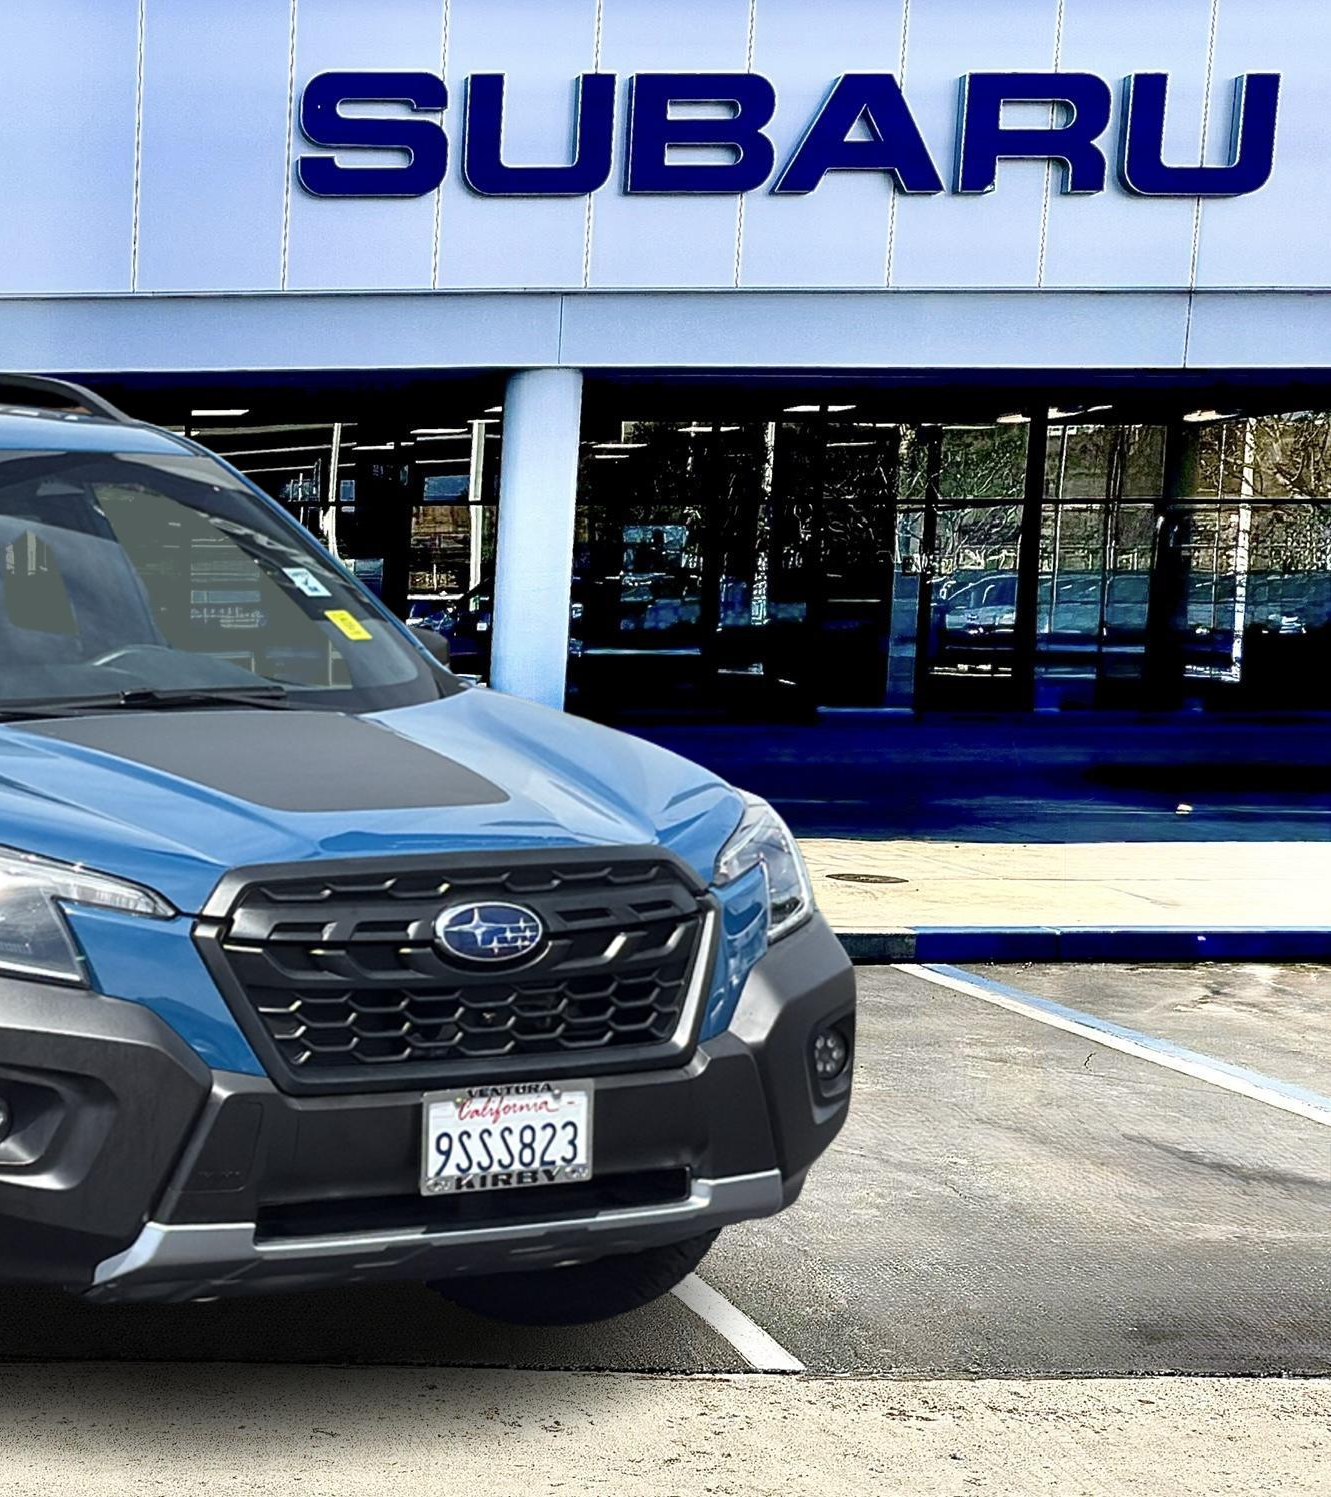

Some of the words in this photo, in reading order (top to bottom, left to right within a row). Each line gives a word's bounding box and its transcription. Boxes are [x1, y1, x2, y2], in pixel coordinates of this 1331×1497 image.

[297, 71, 1282, 196] SUBARU
[467, 1083, 553, 1098] VENTURA
[458, 1097, 558, 1124] California
[435, 1121, 578, 1177] 9SSS823
[455, 1167, 560, 1190] KIRBY
